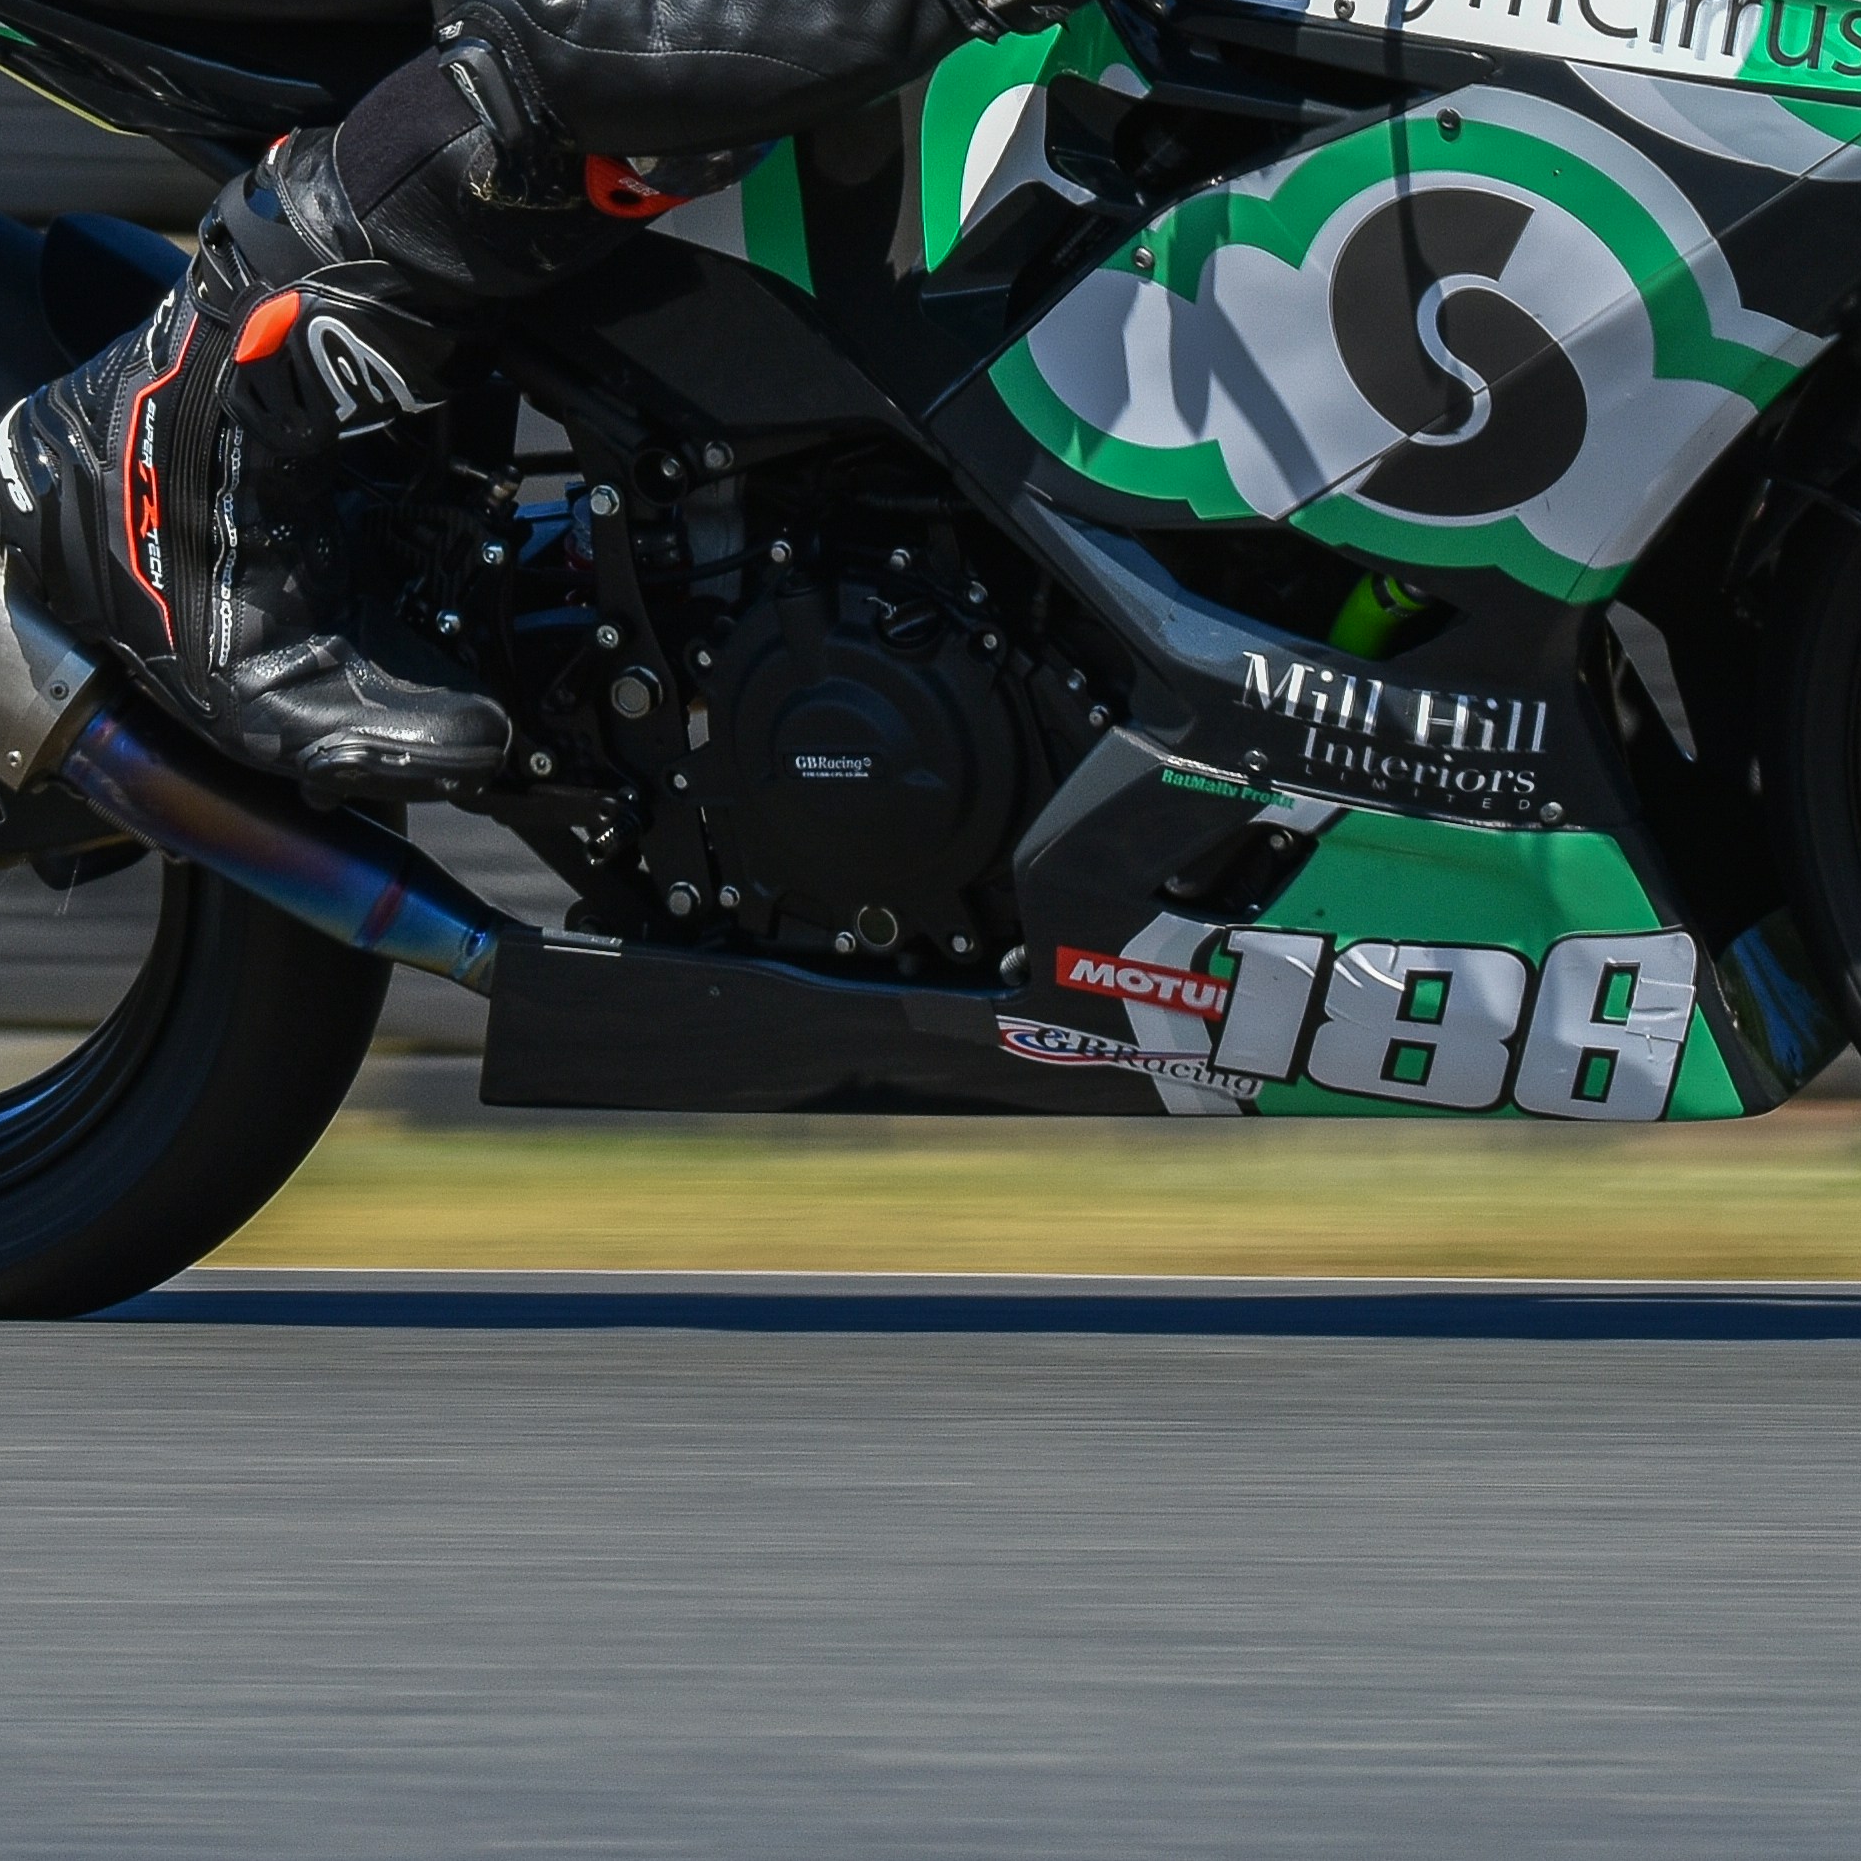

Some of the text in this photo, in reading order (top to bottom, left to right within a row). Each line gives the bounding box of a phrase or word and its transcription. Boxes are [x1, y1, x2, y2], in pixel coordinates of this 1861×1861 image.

[141, 397, 157, 469] SUPER
[146, 527, 165, 591] TECH
[1233, 650, 1547, 754] Mill Hill
[1298, 726, 1537, 794] Interiors
[1304, 762, 1533, 812] LIMITED
